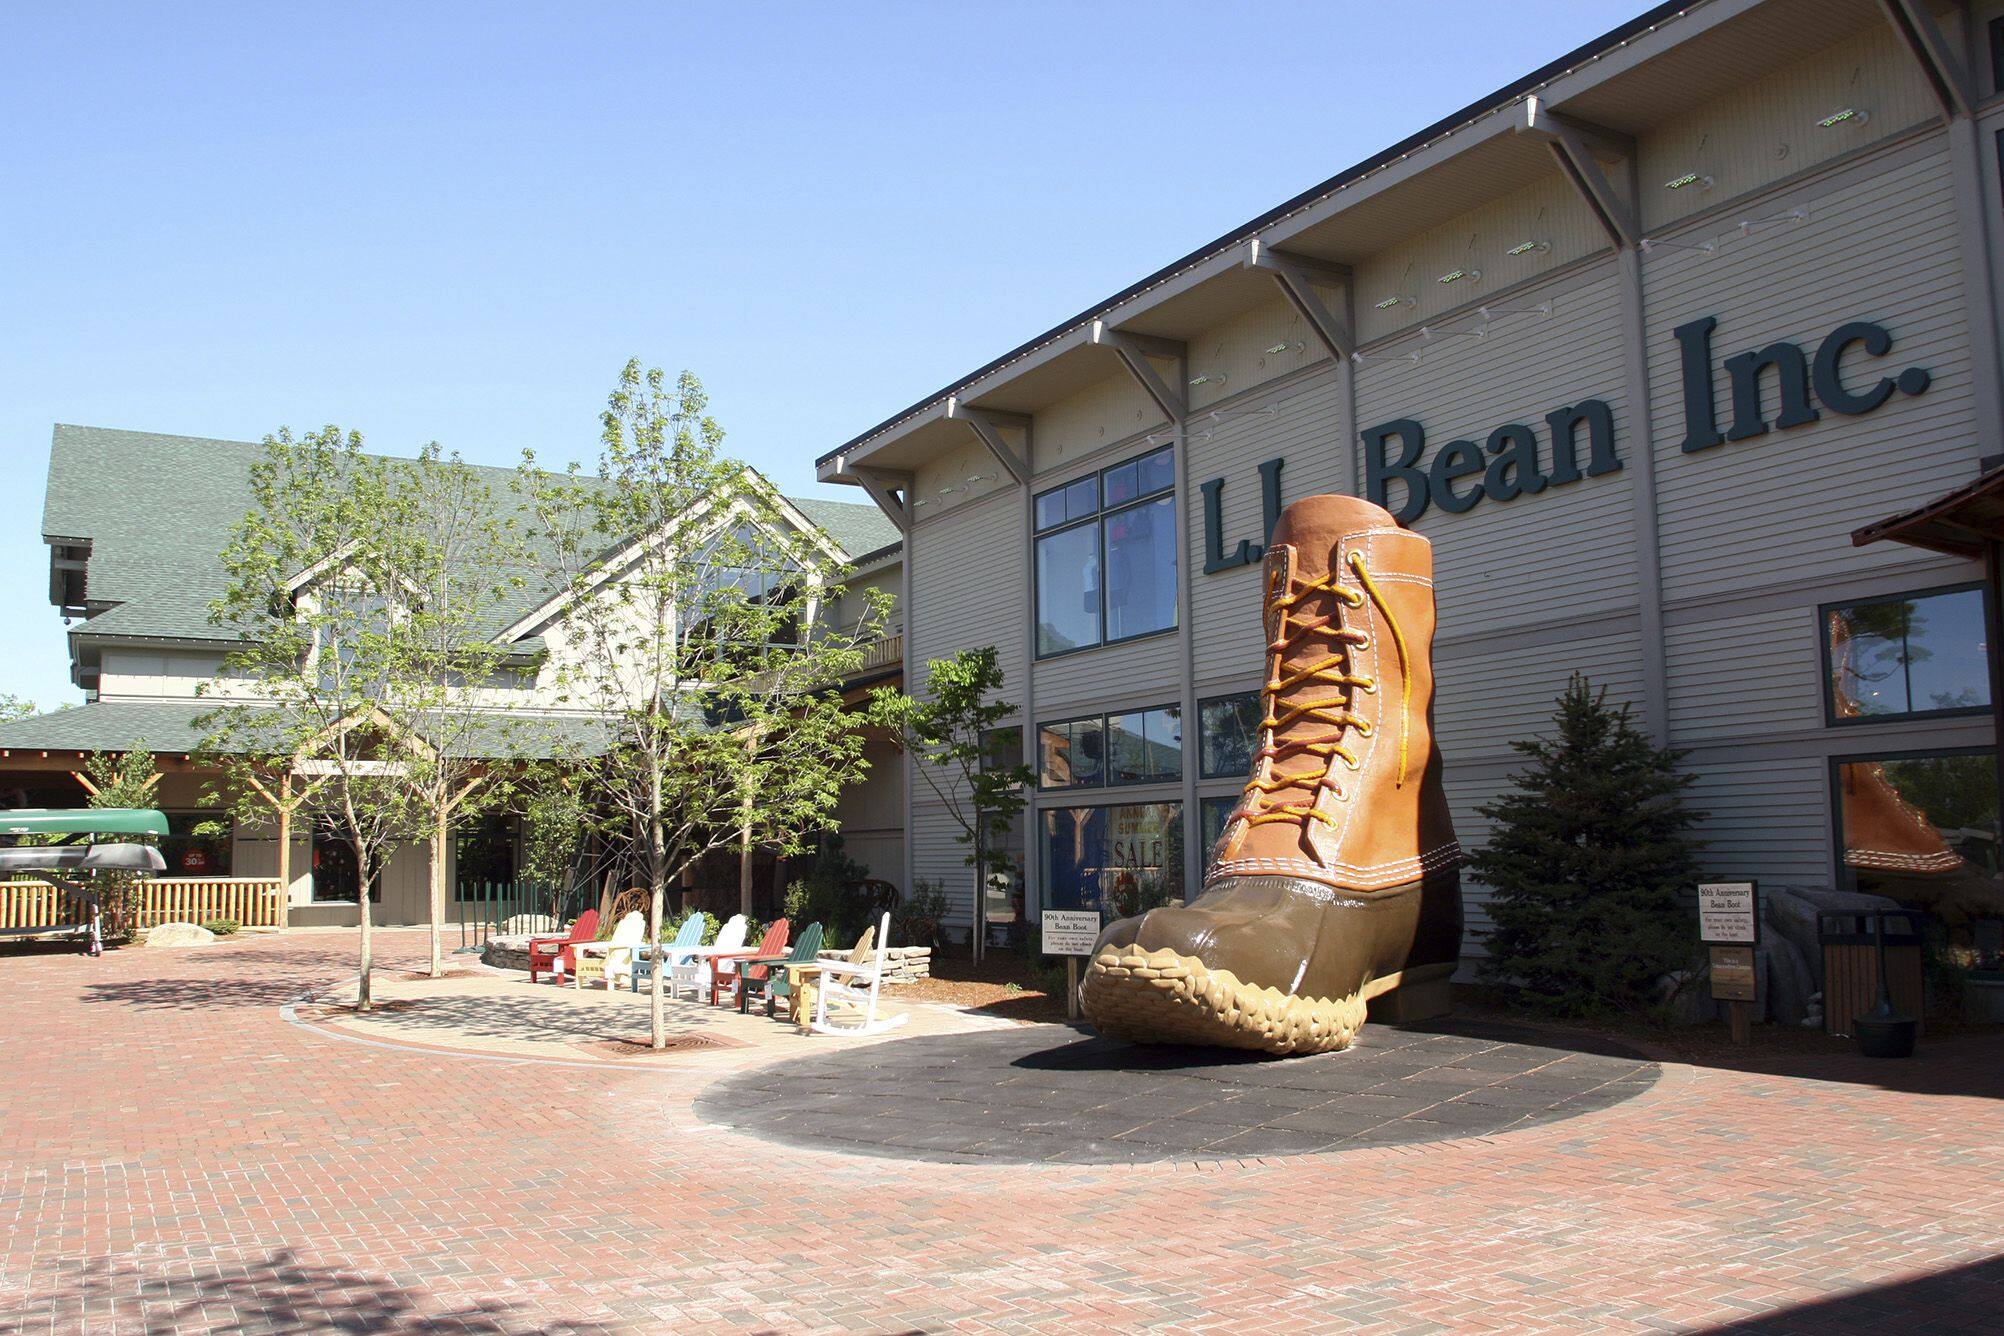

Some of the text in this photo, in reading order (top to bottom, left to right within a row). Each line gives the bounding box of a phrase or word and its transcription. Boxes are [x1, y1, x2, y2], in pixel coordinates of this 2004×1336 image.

[1200, 316, 1931, 576] L.L Bean Inc.
[1115, 841, 1163, 868] SALE
[185, 857, 197, 866] 30
[1700, 888, 1749, 898] 90th Anniversary
[1710, 899, 1741, 909] Bean Boot
[1044, 913, 1097, 923] 90th Anniversary
[1072, 923, 1088, 931] Boot
